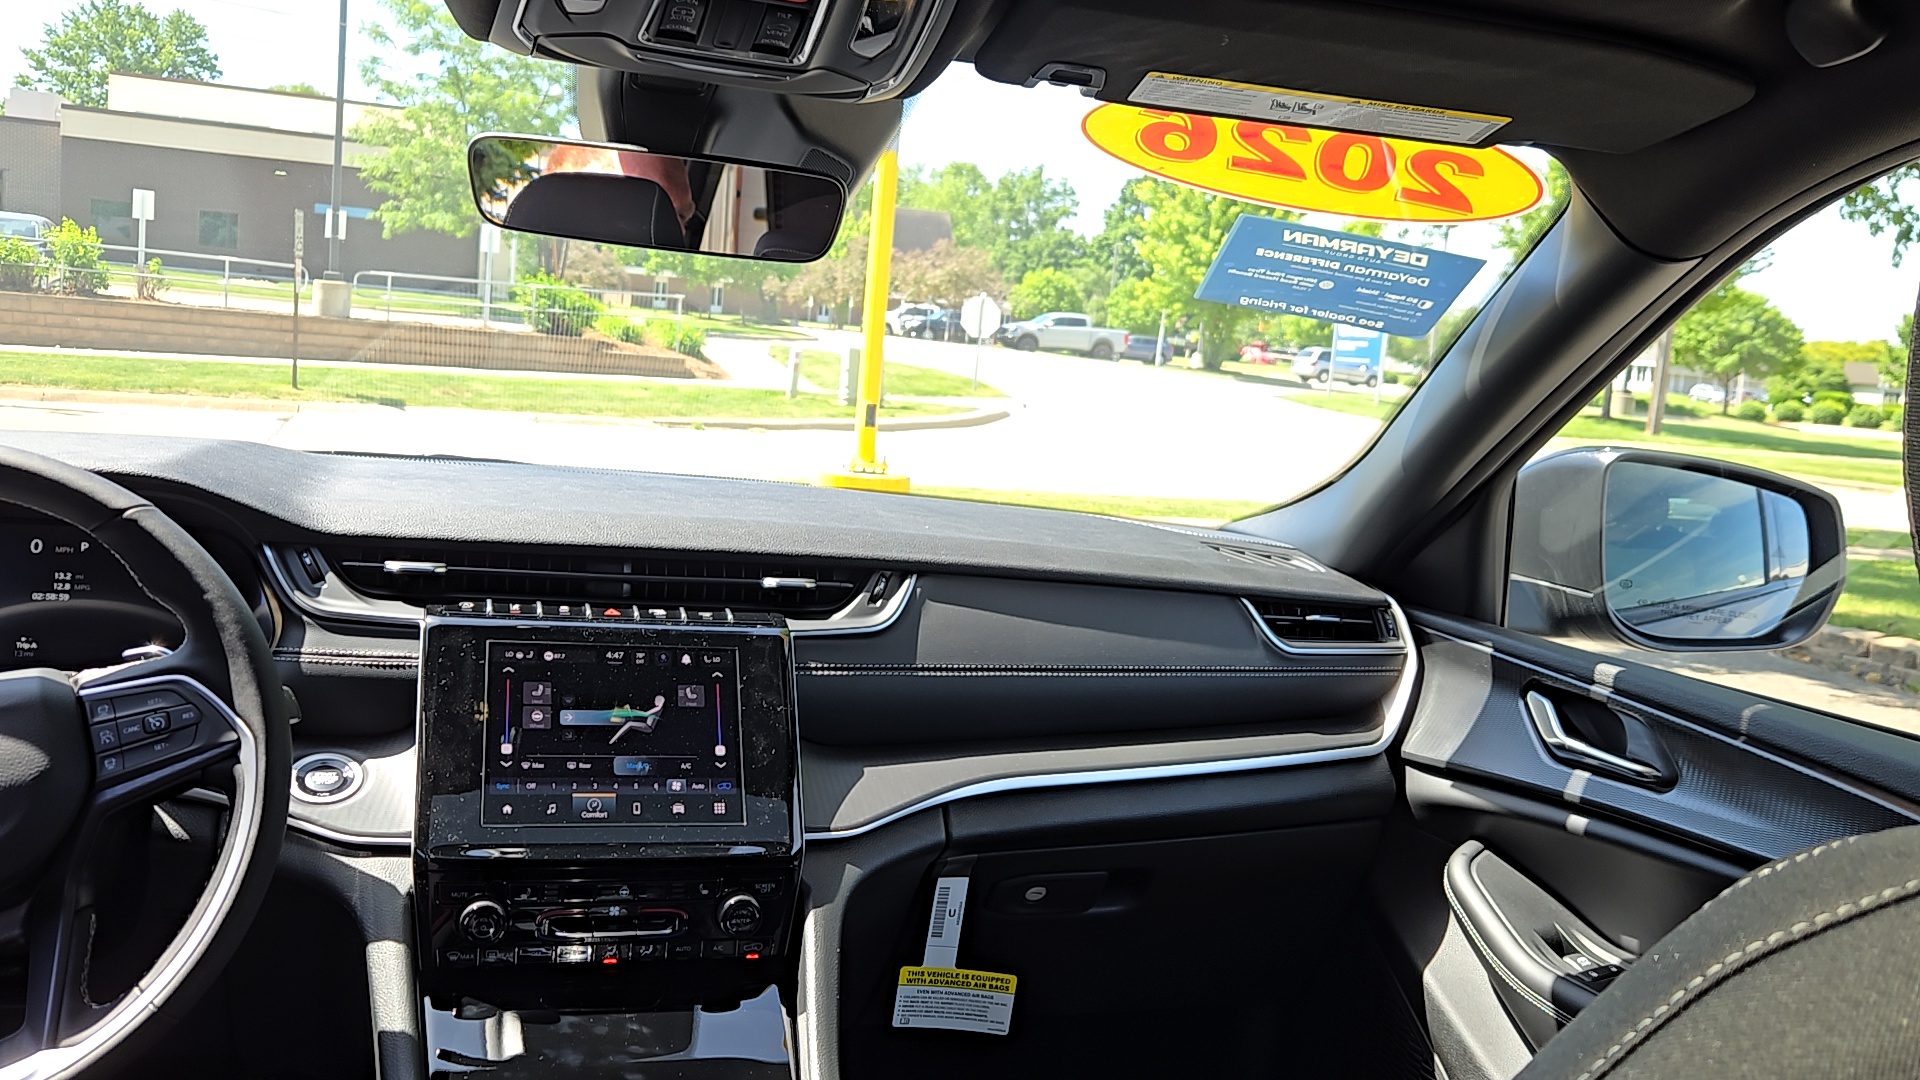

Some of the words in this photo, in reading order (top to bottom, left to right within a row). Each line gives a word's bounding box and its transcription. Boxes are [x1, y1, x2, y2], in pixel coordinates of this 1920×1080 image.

[670, 15, 693, 23] AUTO
[777, 12, 792, 20] TILT
[761, 39, 786, 47] DOWN
[1172, 75, 1224, 86] WARNING
[1411, 107, 1447, 115] GARDE
[30, 538, 44, 554] 0
[55, 545, 75, 554] MPH
[80, 541, 90, 553] P
[54, 572, 73, 580] 13.2
[53, 582, 71, 591] 12.8
[31, 592, 71, 601] 02:58:59
[15, 641, 31, 650] Trip
[31, 641, 38, 649] A
[605, 651, 625, 660] 4:47
[181, 711, 195, 720] RES
[122, 724, 141, 734] CANC
[495, 783, 511, 791] Sync
[525, 782, 538, 790] Off
[572, 782, 578, 790] 2
[592, 782, 599, 790] 3
[613, 782, 619, 790] 4
[633, 782, 639, 790] 5
[691, 782, 706, 790] Auto
[580, 811, 608, 819] Comfort
[948, 908, 957, 918] U
[907, 970, 925, 978] THIS
[926, 971, 960, 980] VEHICLE
[970, 974, 1011, 985] EQUIPPED
[906, 977, 927, 985] WITH
[927, 978, 972, 987] ADVANCED
[972, 981, 988, 989] AIR
[988, 983, 1010, 992] BAGS
[943, 990, 971, 998] ADVANCED
